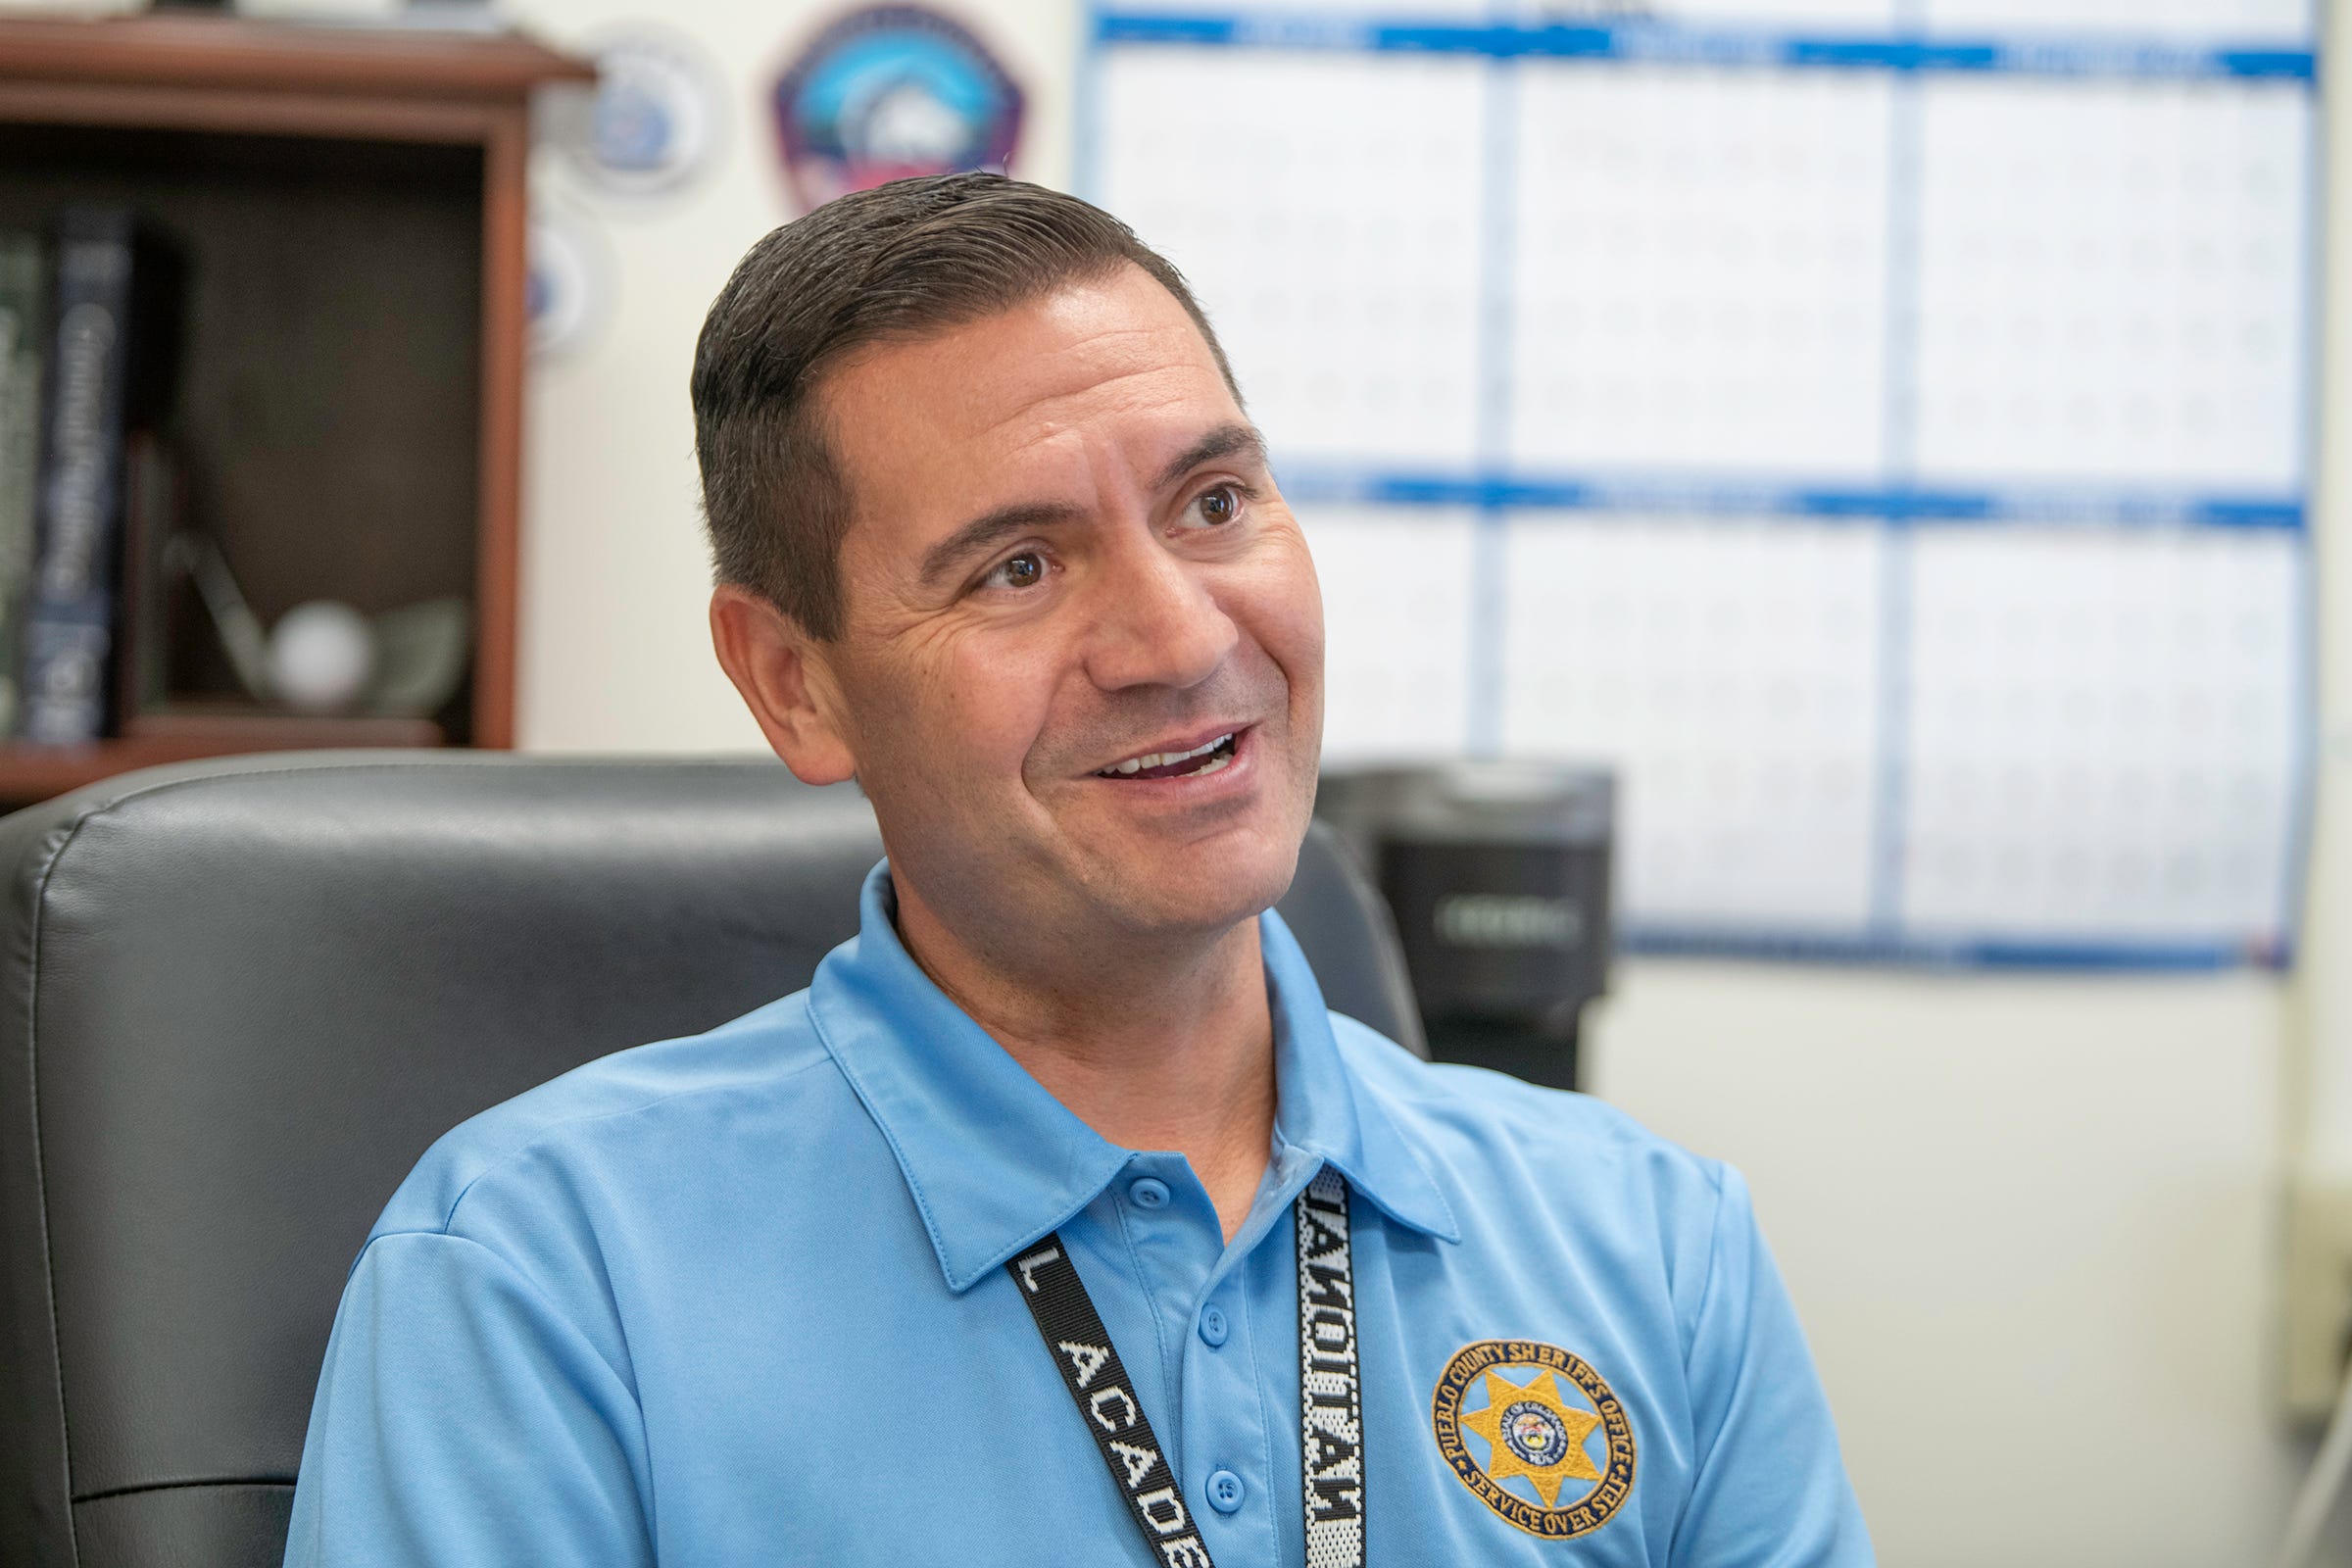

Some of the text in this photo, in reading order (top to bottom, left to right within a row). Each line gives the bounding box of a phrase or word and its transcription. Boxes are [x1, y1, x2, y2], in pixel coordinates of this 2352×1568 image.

[1437, 1344, 1633, 1464] PUEBLO COUNTY SHERIFF'S OFFICE
[1464, 1471, 1629, 1535] SERVICE OVER SELF
